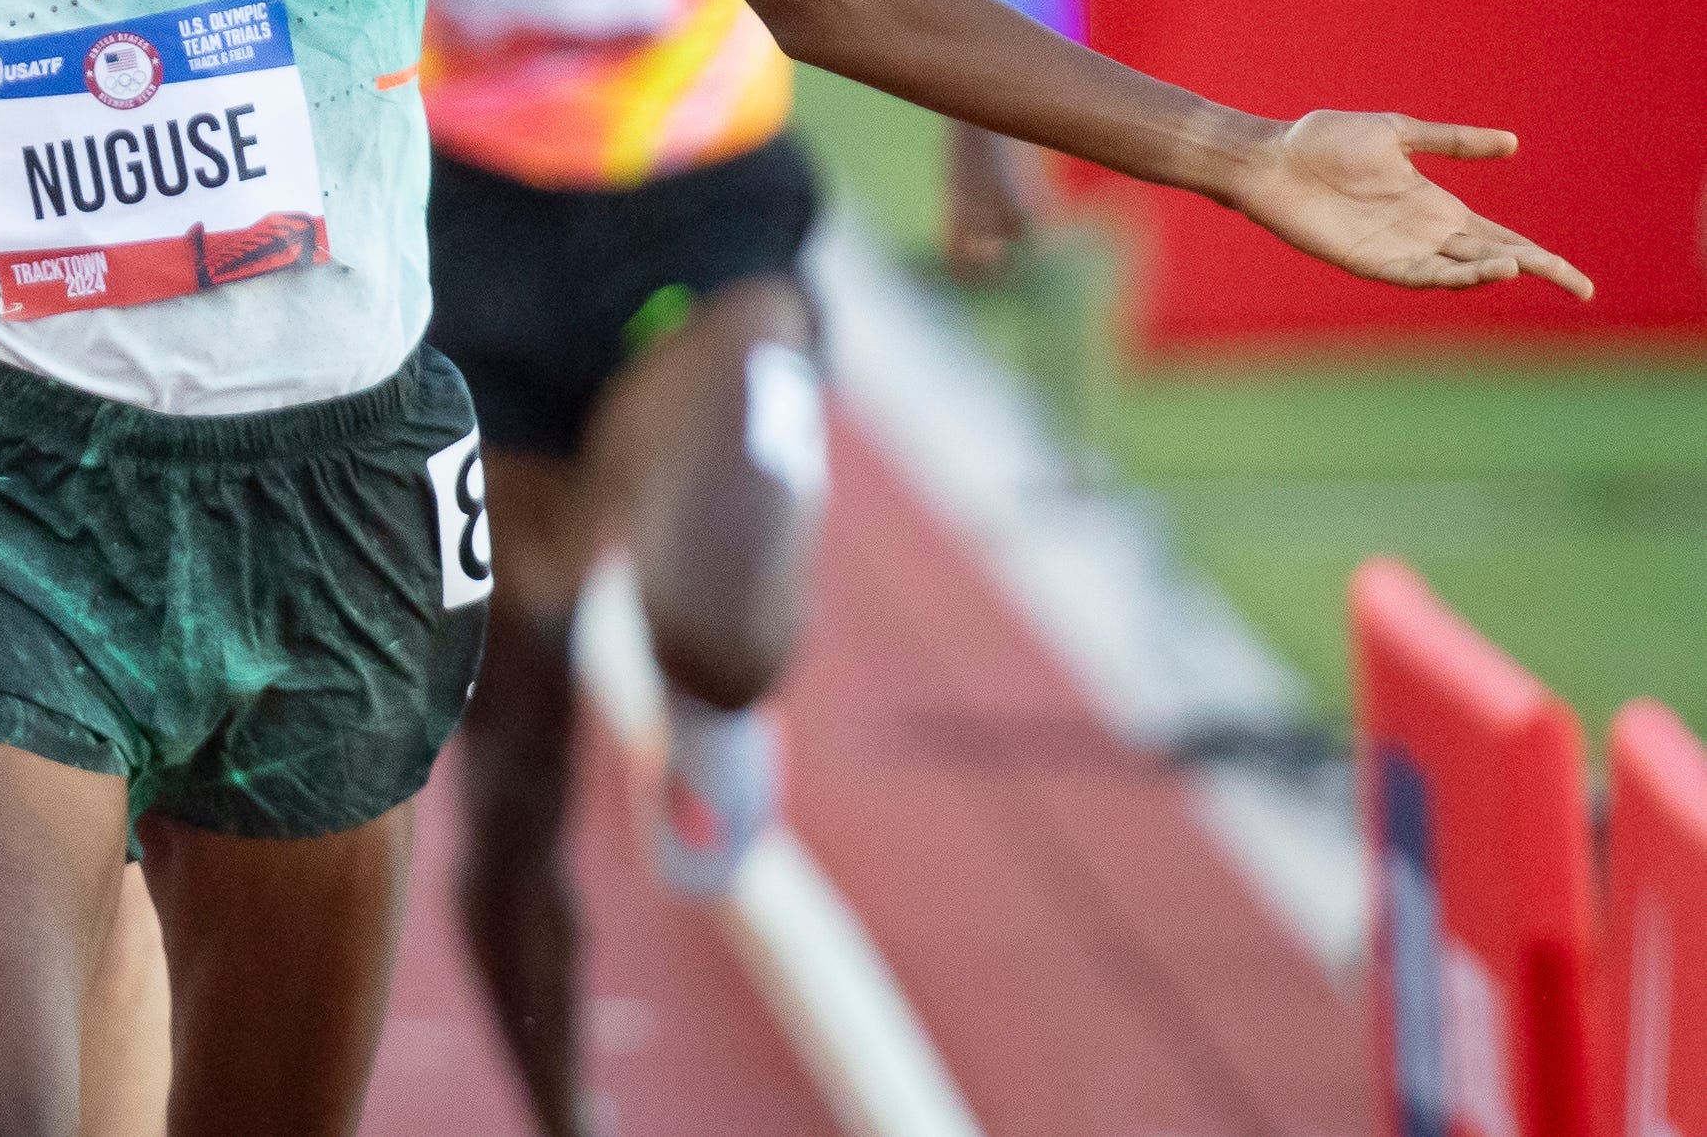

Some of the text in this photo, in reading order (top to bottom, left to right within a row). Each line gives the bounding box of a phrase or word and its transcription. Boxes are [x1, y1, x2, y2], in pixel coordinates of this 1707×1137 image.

[178, 2, 269, 37] U.S. OLYMPIC
[182, 21, 272, 57] TEAM TRIALS
[4, 56, 63, 81] USATF
[187, 53, 221, 71] TRACK
[229, 45, 254, 62] FIELD
[21, 102, 267, 220] NUGUSE
[67, 273, 106, 297] 2024
